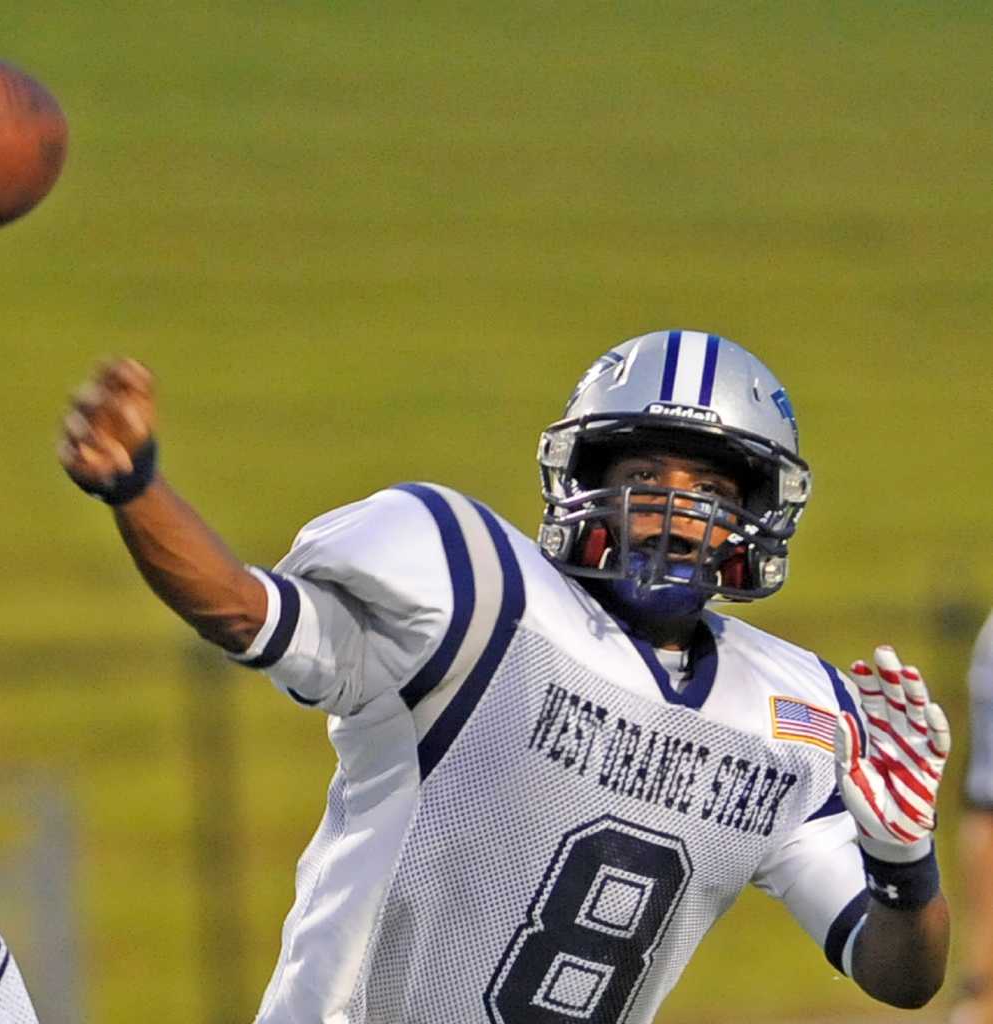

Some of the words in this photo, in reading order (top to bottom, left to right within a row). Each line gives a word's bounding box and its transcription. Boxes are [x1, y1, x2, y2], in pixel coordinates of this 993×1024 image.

[529, 683, 608, 775] WEST
[599, 718, 709, 813] ORANGE
[701, 754, 797, 837] STARK
